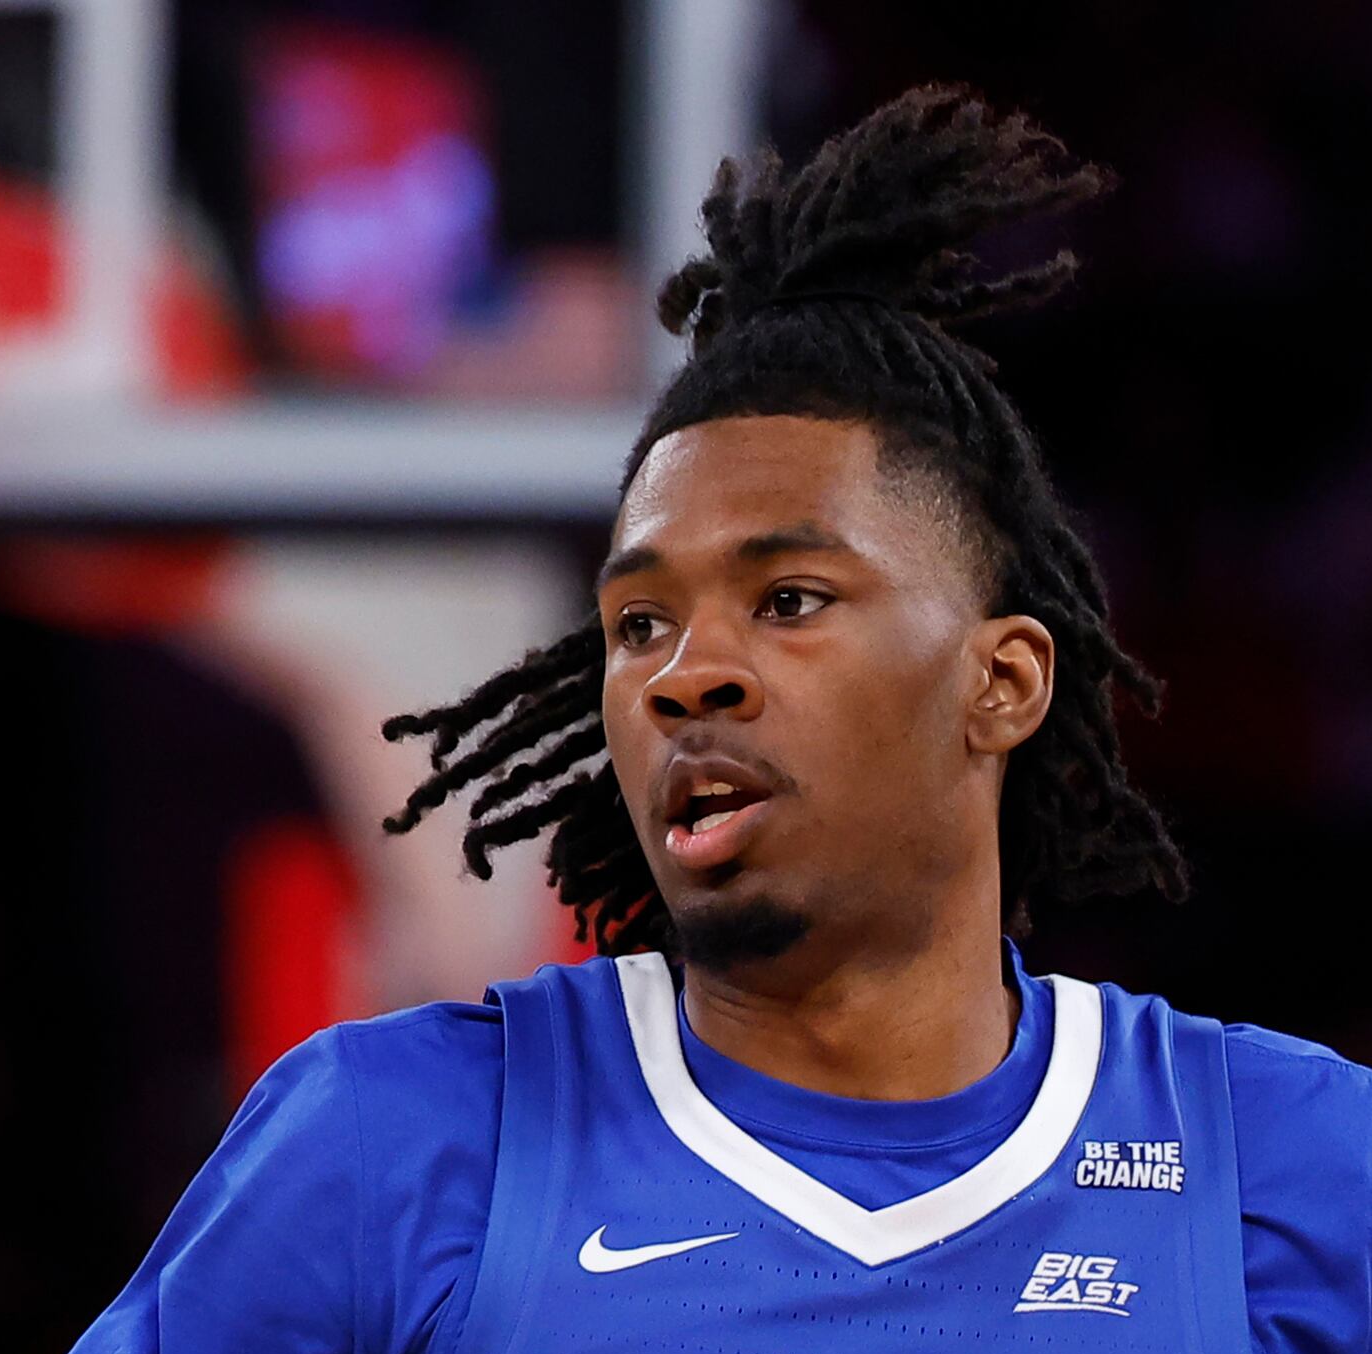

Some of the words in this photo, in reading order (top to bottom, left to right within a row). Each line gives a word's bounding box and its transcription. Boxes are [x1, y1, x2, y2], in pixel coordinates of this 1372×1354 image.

[1084, 1141, 1120, 1160] BE
[1127, 1142, 1180, 1164] THE
[1076, 1160, 1185, 1193] CHANGE
[1032, 1252, 1118, 1280] BIG
[1020, 1277, 1139, 1305] EAST
